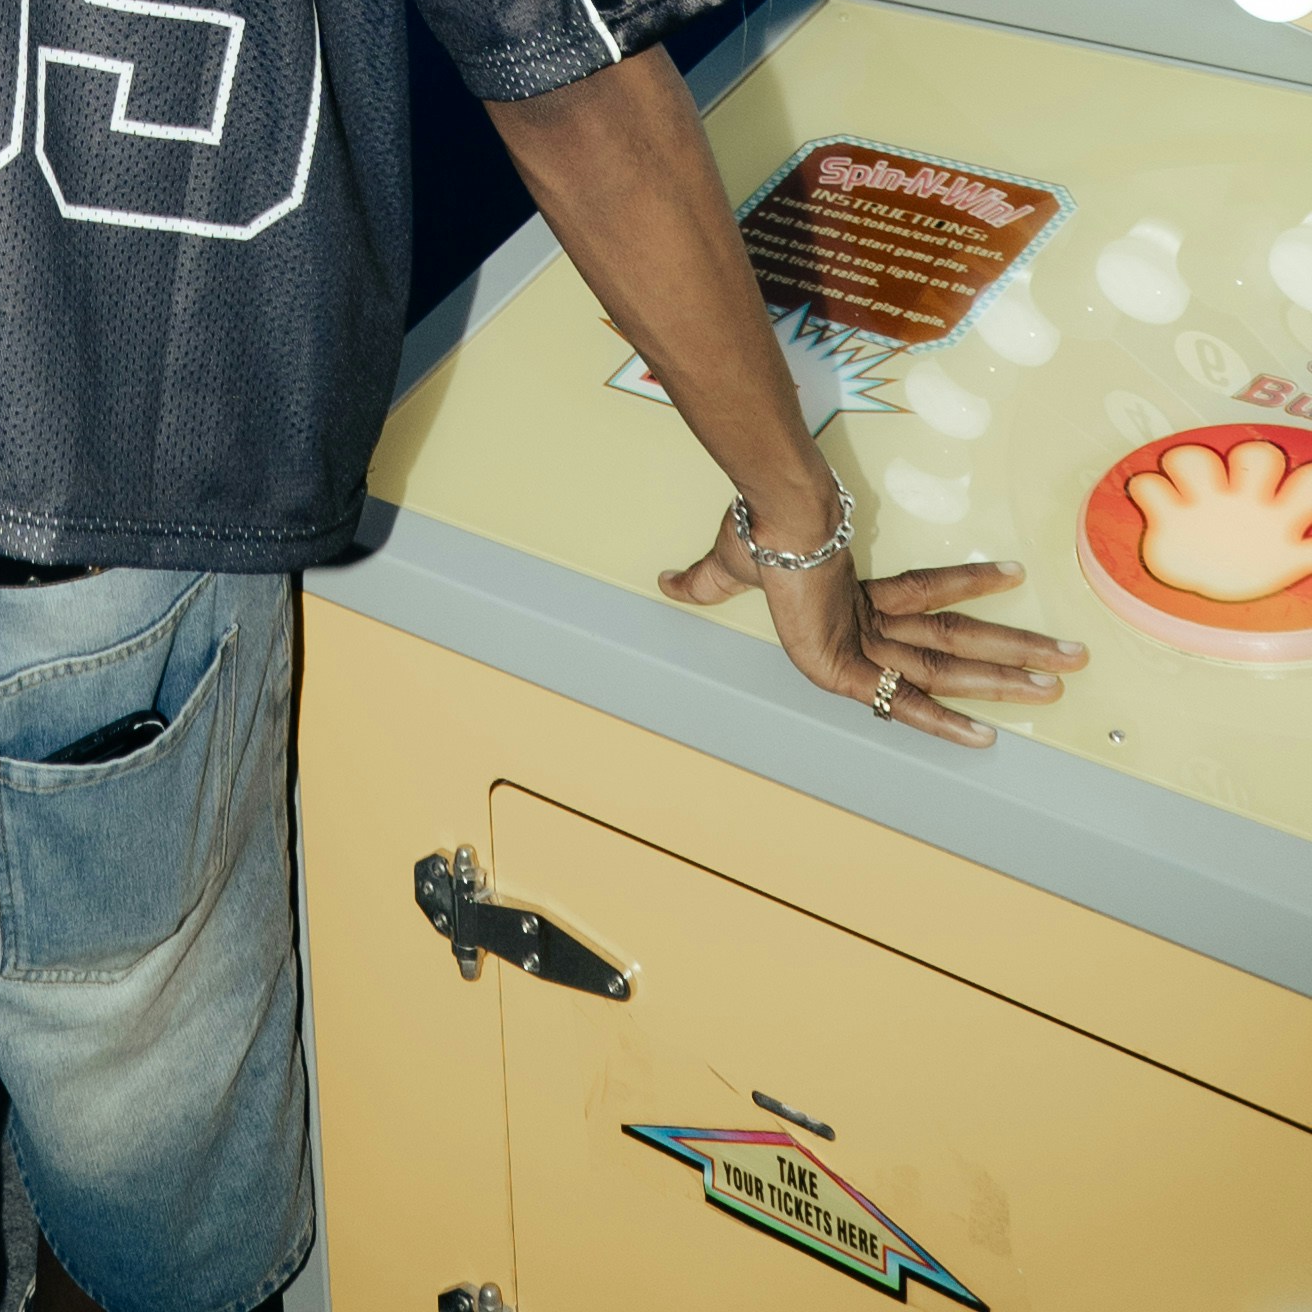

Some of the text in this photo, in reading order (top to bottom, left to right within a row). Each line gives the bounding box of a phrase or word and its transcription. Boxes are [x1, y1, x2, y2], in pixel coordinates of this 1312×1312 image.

[811, 188, 989, 242] INSTRUCTIONS:
[794, 220, 841, 239] handle
[842, 232, 858, 244] to
[858, 238, 895, 253] start
[893, 247, 934, 264] game
[947, 239, 963, 251] to
[836, 252, 852, 263] to
[853, 257, 885, 272] stop
[930, 278, 950, 289] on
[844, 294, 874, 307] and
[776, 1155, 819, 1200] TAKE
[722, 1160, 879, 1260] YOUR TICKETS HERE
